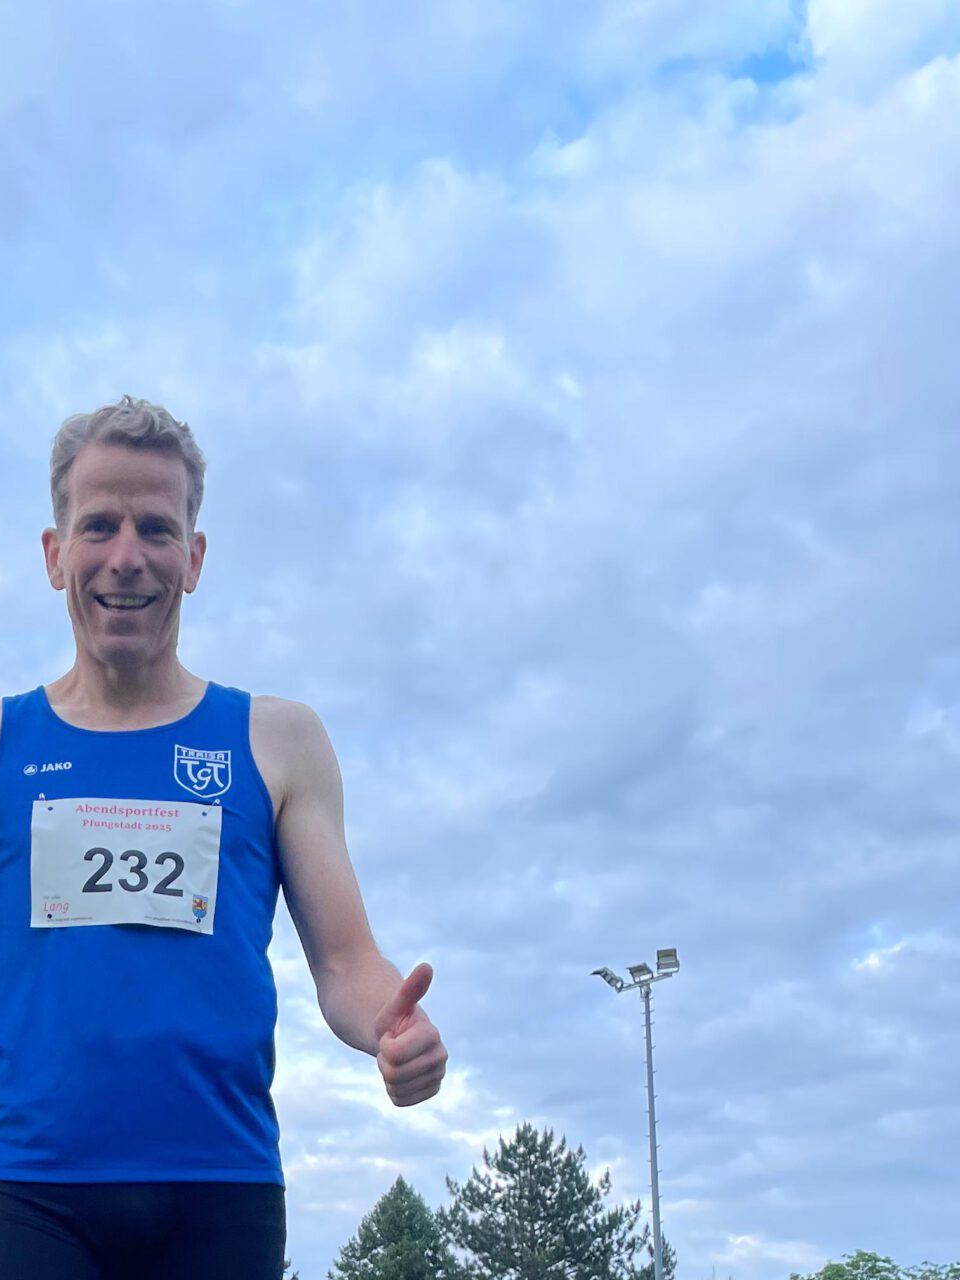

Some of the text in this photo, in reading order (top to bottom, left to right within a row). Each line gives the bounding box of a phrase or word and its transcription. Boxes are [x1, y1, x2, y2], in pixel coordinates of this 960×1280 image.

[180, 748, 225, 761] TRAISA
[40, 761, 73, 773] JAKO
[75, 804, 181, 818] Abendsportfest
[82, 819, 172, 832] Pfungstadt 2025
[81, 847, 185, 897] 232
